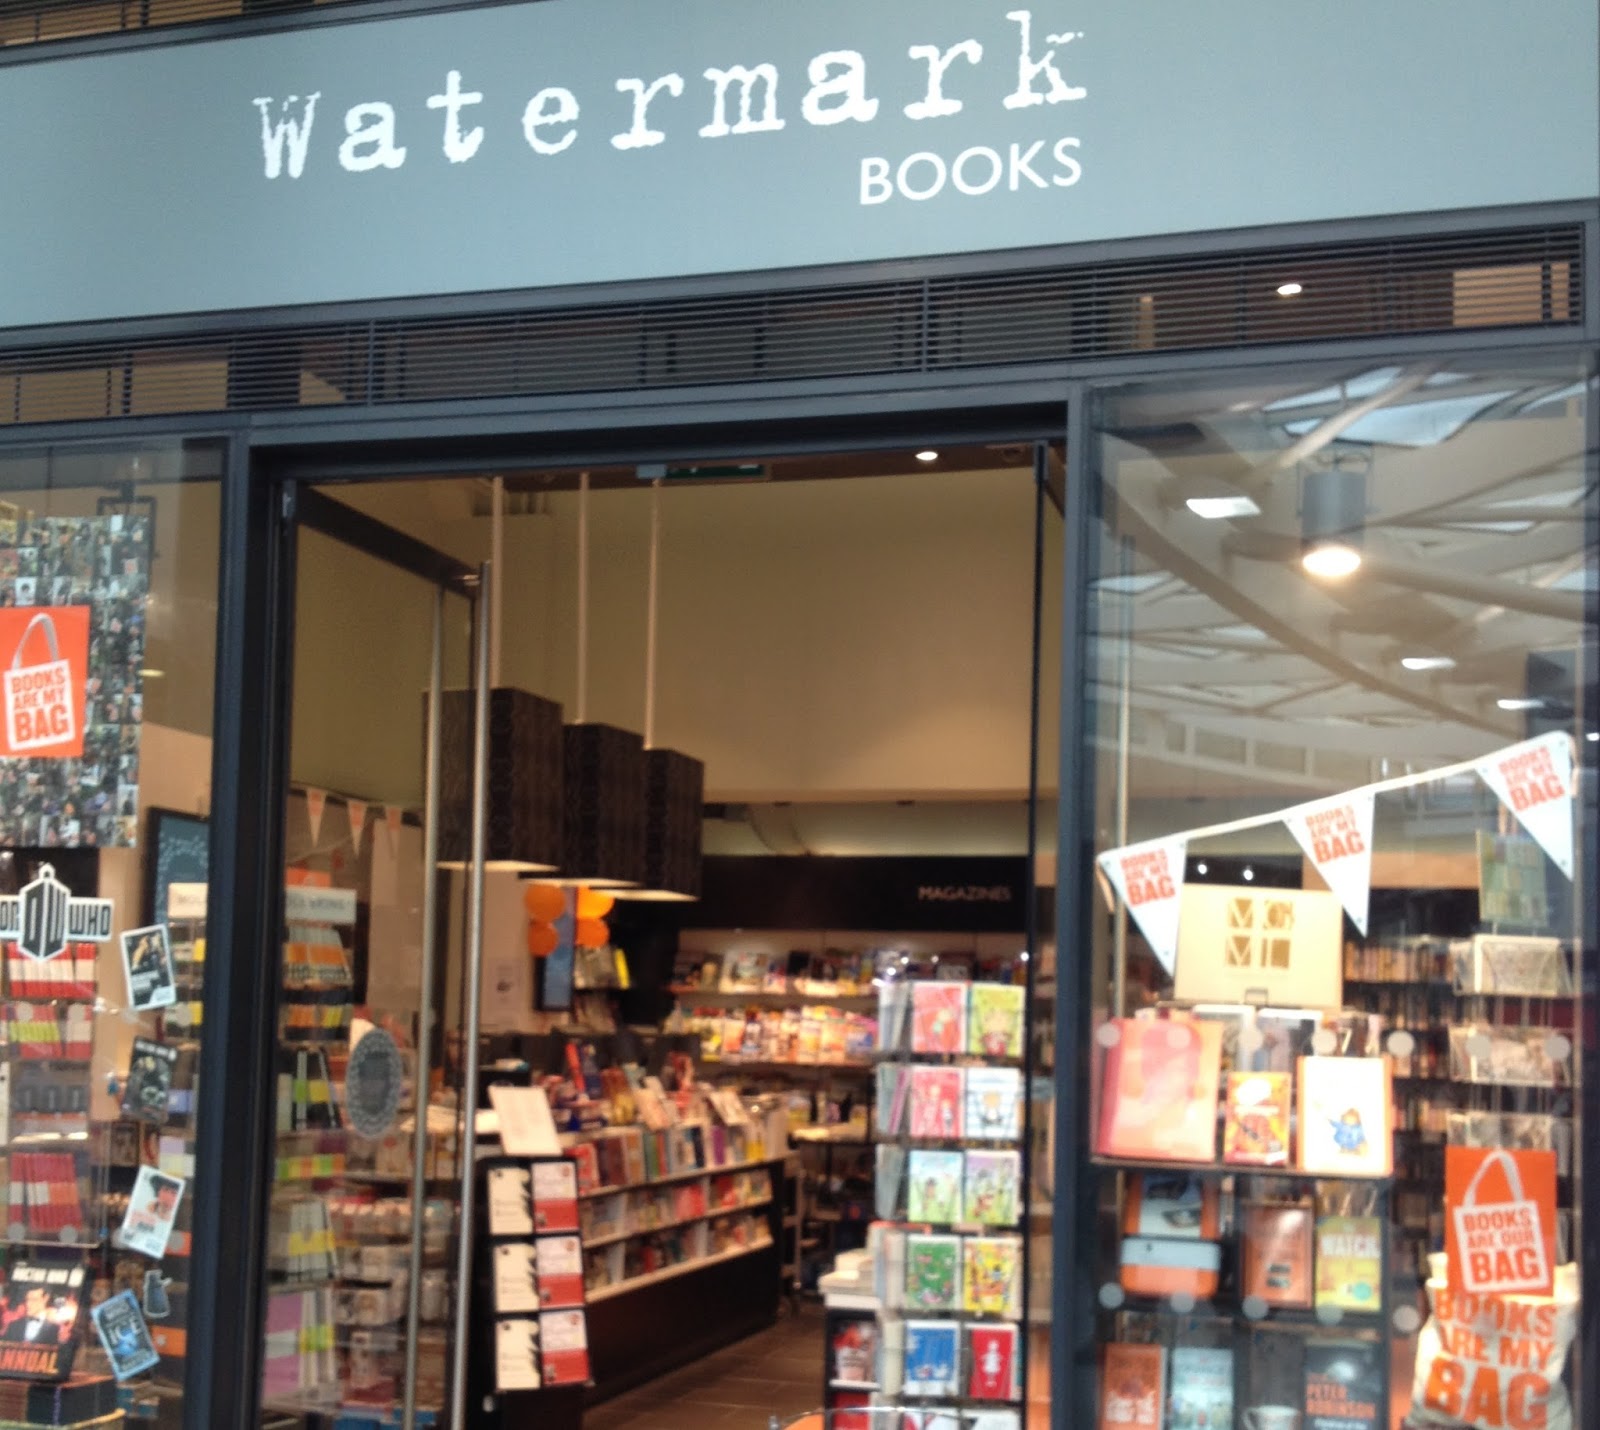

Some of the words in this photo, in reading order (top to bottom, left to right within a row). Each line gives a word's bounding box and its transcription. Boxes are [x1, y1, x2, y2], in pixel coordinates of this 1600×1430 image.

[252, 9, 1087, 179] Watermark
[859, 136, 1082, 205] BOOKS
[12, 666, 66, 694] BOOKS
[15, 704, 70, 743] BAG
[1498, 745, 1551, 776] BOOKS
[1510, 774, 1566, 812] BAG
[1305, 804, 1354, 827] BOOKS
[1120, 848, 1167, 870] BOOKS
[1313, 830, 1365, 864] BAG
[1127, 875, 1176, 907] BAG
[69, 902, 111, 937] WHO
[1464, 1208, 1532, 1233] BOOKS
[1470, 1247, 1541, 1284] BAG
[1500, 1335, 1556, 1371] MY
[1422, 1356, 1552, 1430] BAG
